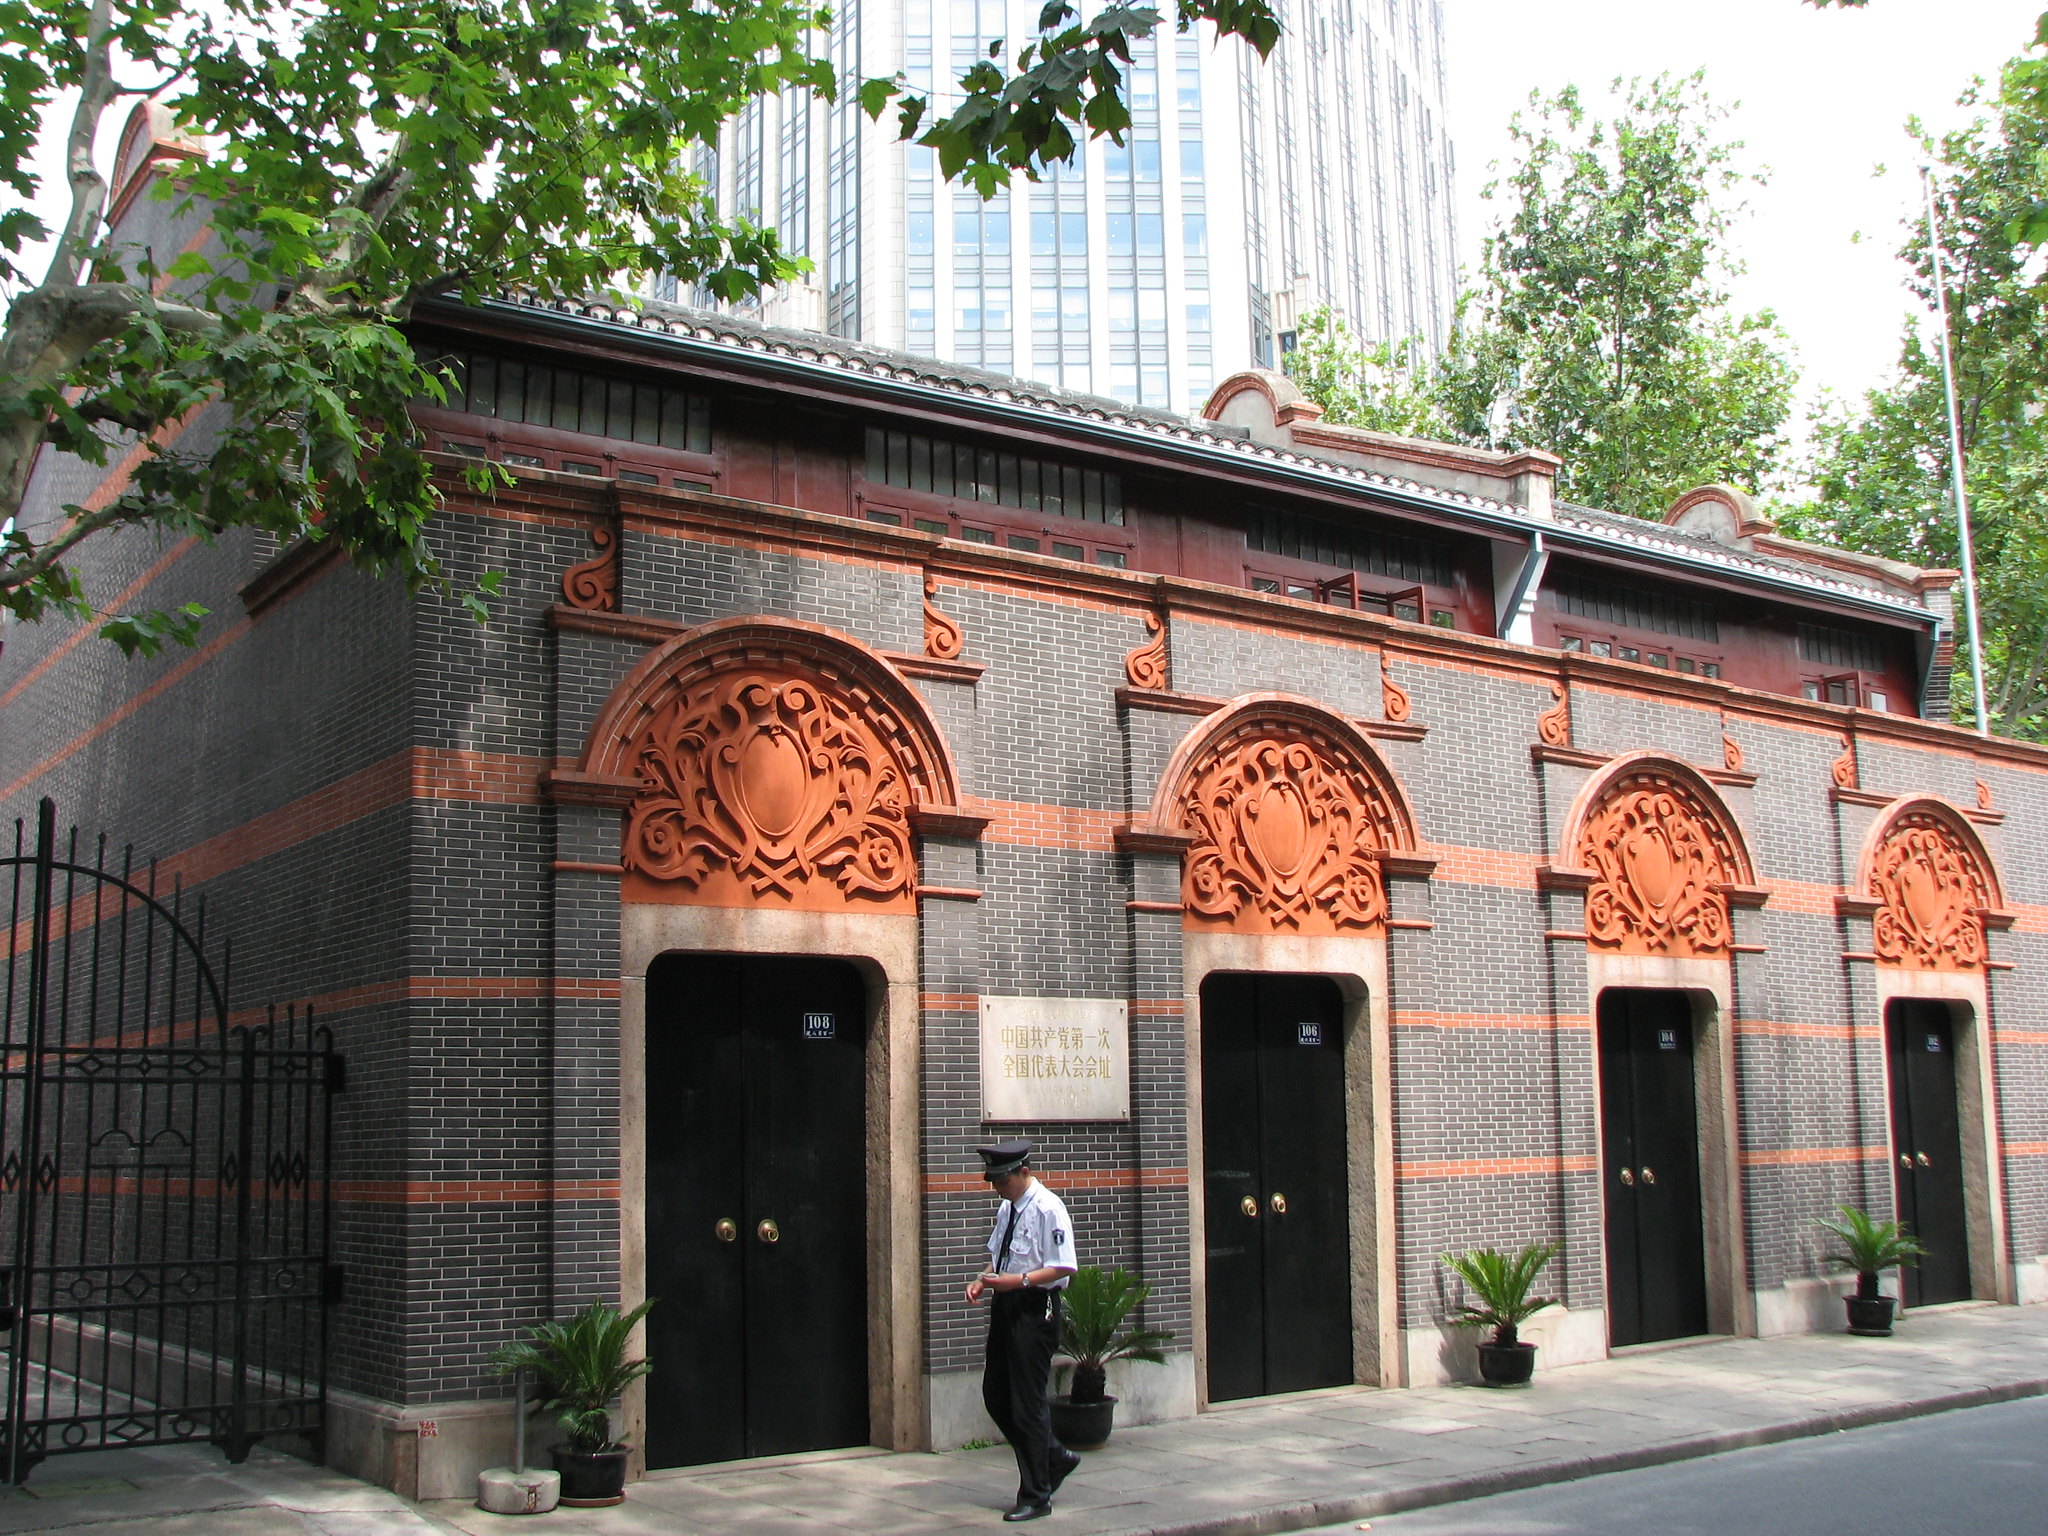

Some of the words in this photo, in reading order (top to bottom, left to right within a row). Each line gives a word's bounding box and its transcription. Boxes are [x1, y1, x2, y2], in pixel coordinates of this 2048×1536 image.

[807, 1015, 830, 1029] 108
[1302, 1024, 1318, 1037] 106
[1001, 1025, 1111, 1050] 中国共产党第一次
[1002, 1054, 1112, 1080] 全国代表大会会址
